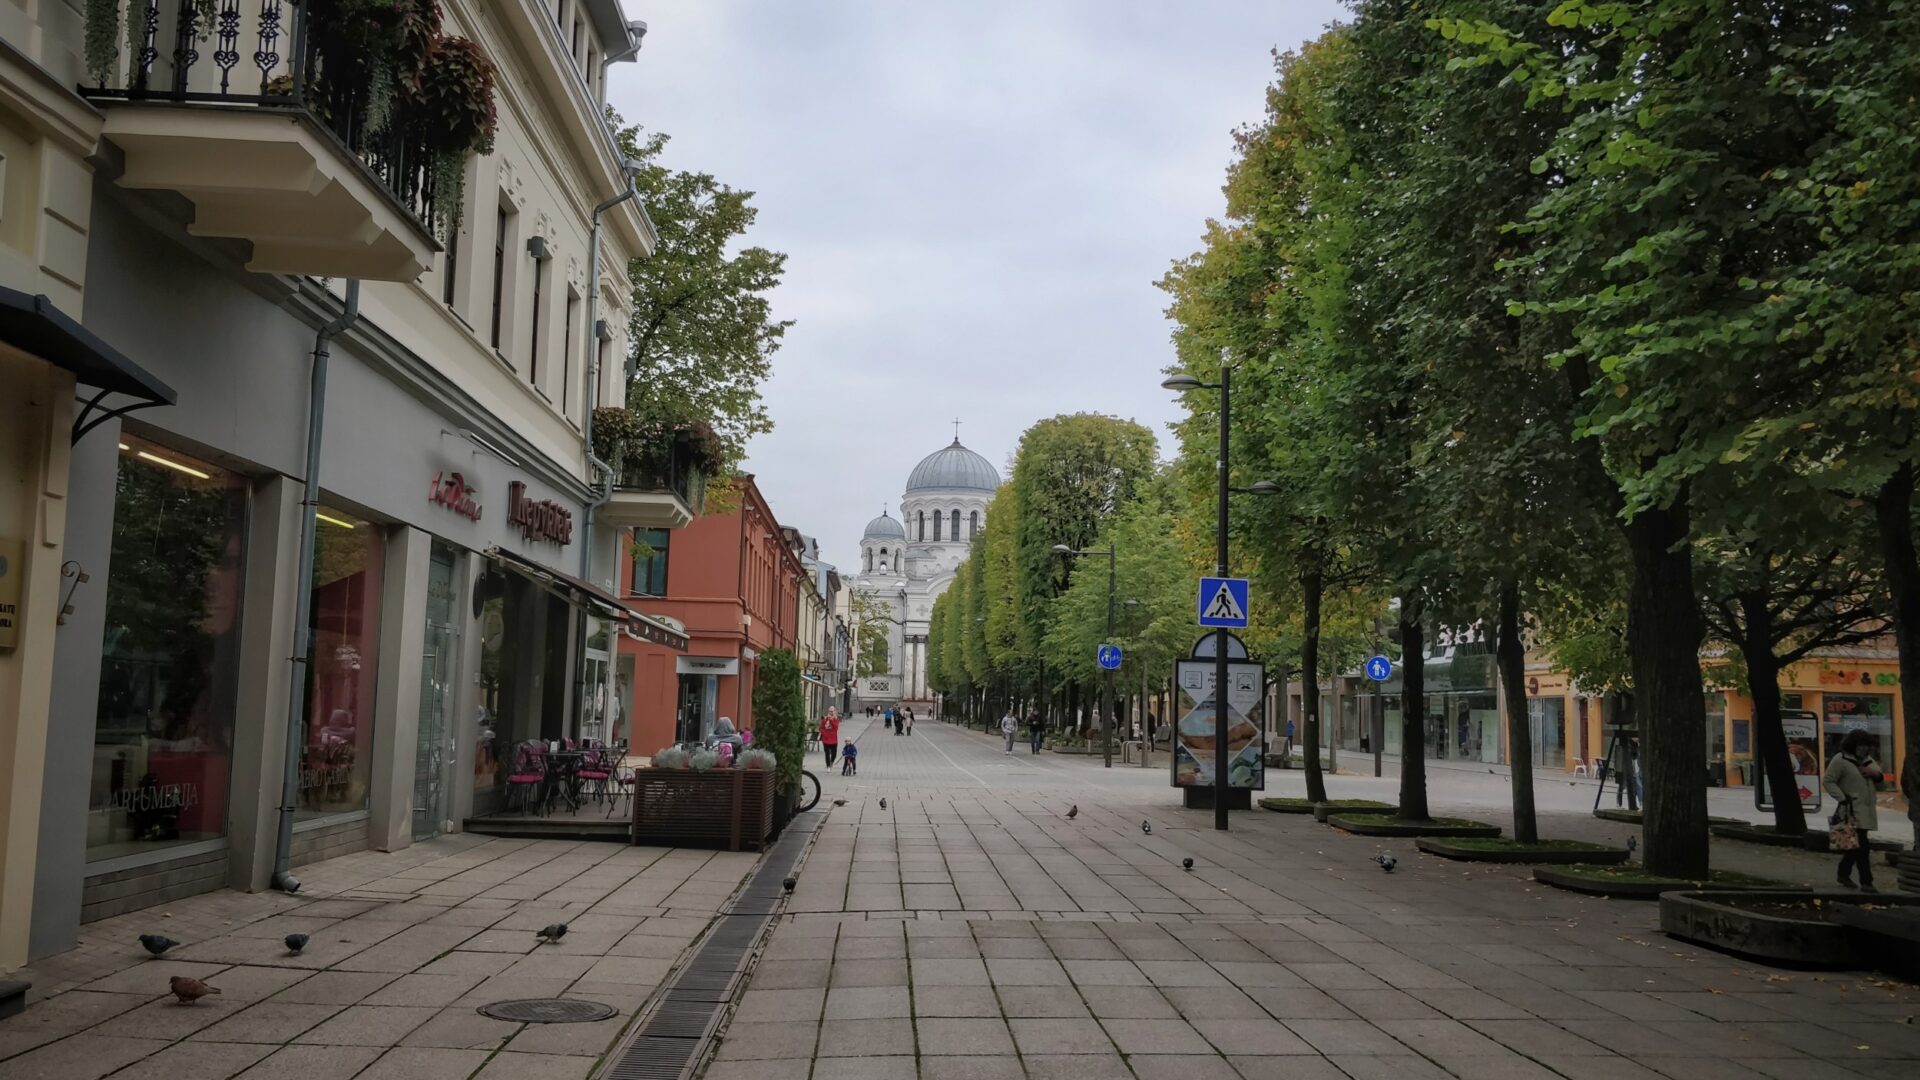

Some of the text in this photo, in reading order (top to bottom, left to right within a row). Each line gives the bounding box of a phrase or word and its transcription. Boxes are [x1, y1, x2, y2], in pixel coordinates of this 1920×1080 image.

[1819, 670, 1860, 685] STOP
[1861, 671, 1872, 685] &
[1827, 702, 1857, 712] STOP
